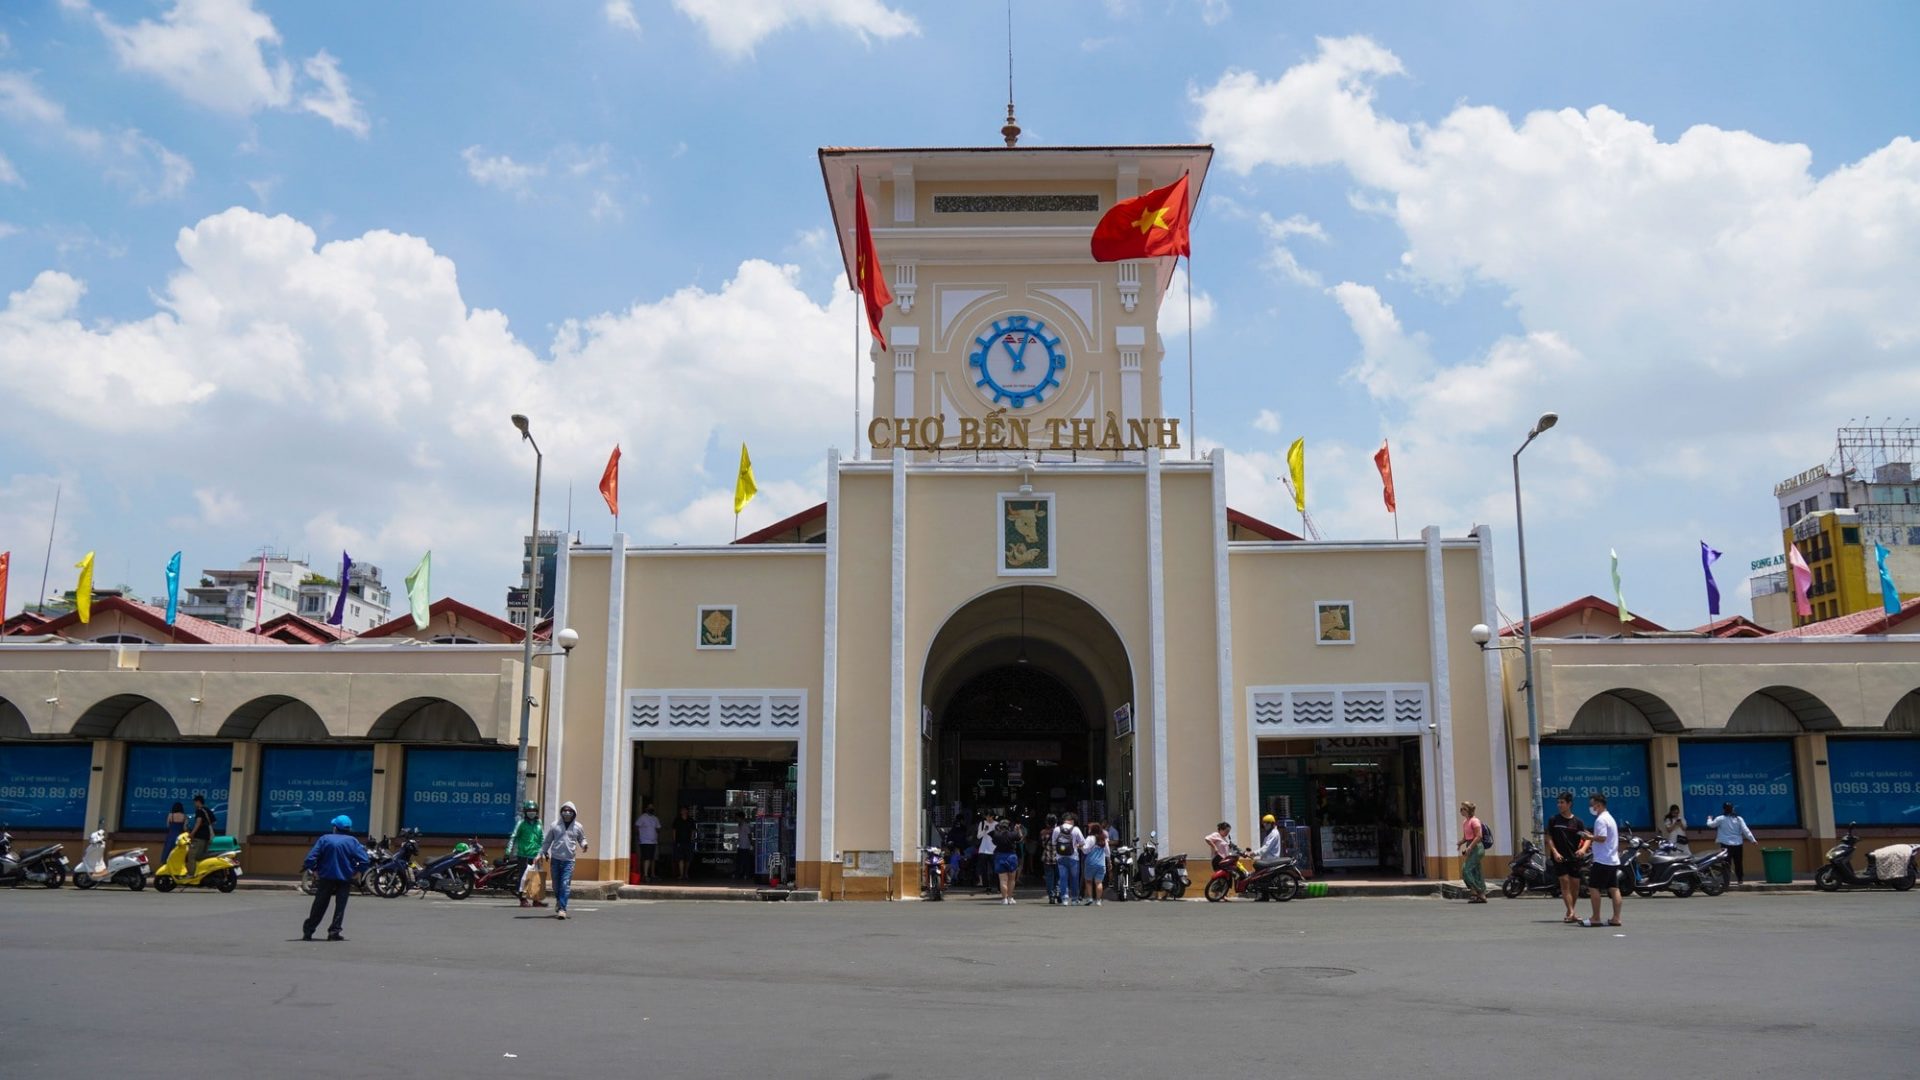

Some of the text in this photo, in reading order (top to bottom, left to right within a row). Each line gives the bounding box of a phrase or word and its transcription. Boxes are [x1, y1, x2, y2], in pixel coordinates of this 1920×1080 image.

[1001, 334, 1037, 344] ASA
[868, 407, 1181, 453] CHỢ BẾN THÀNH
[1751, 558, 1772, 570] SONG
[270, 789, 366, 802] 0969.39.89.89
[1542, 785, 1640, 799] 099.3989.89
[1689, 783, 1788, 796] 0969.39.89.89
[414, 790, 512, 805] 0969.39.89.89
